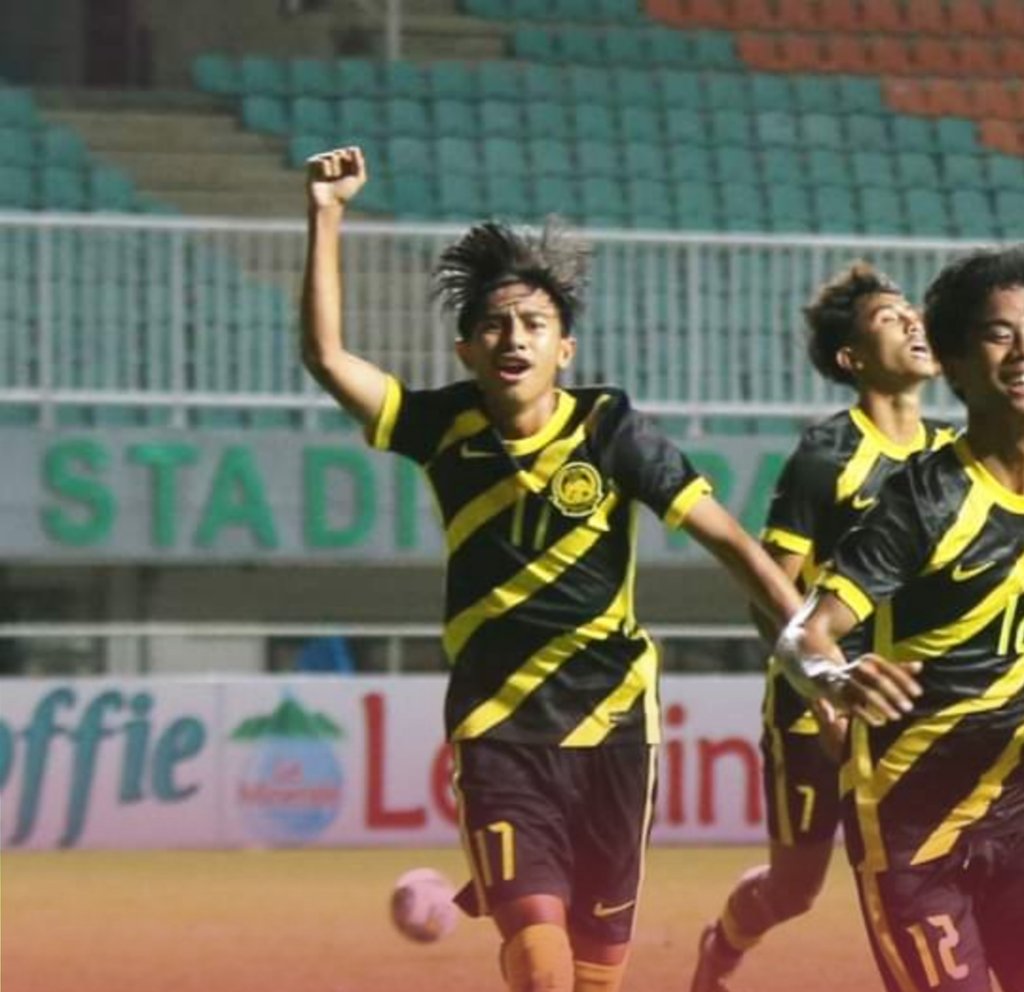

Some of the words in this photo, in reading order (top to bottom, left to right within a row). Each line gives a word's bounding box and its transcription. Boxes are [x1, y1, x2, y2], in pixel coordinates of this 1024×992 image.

[40, 440, 418, 549] STADI
[0, 686, 207, 848] ffie
[474, 820, 516, 887] 17
[906, 914, 969, 987] 12
